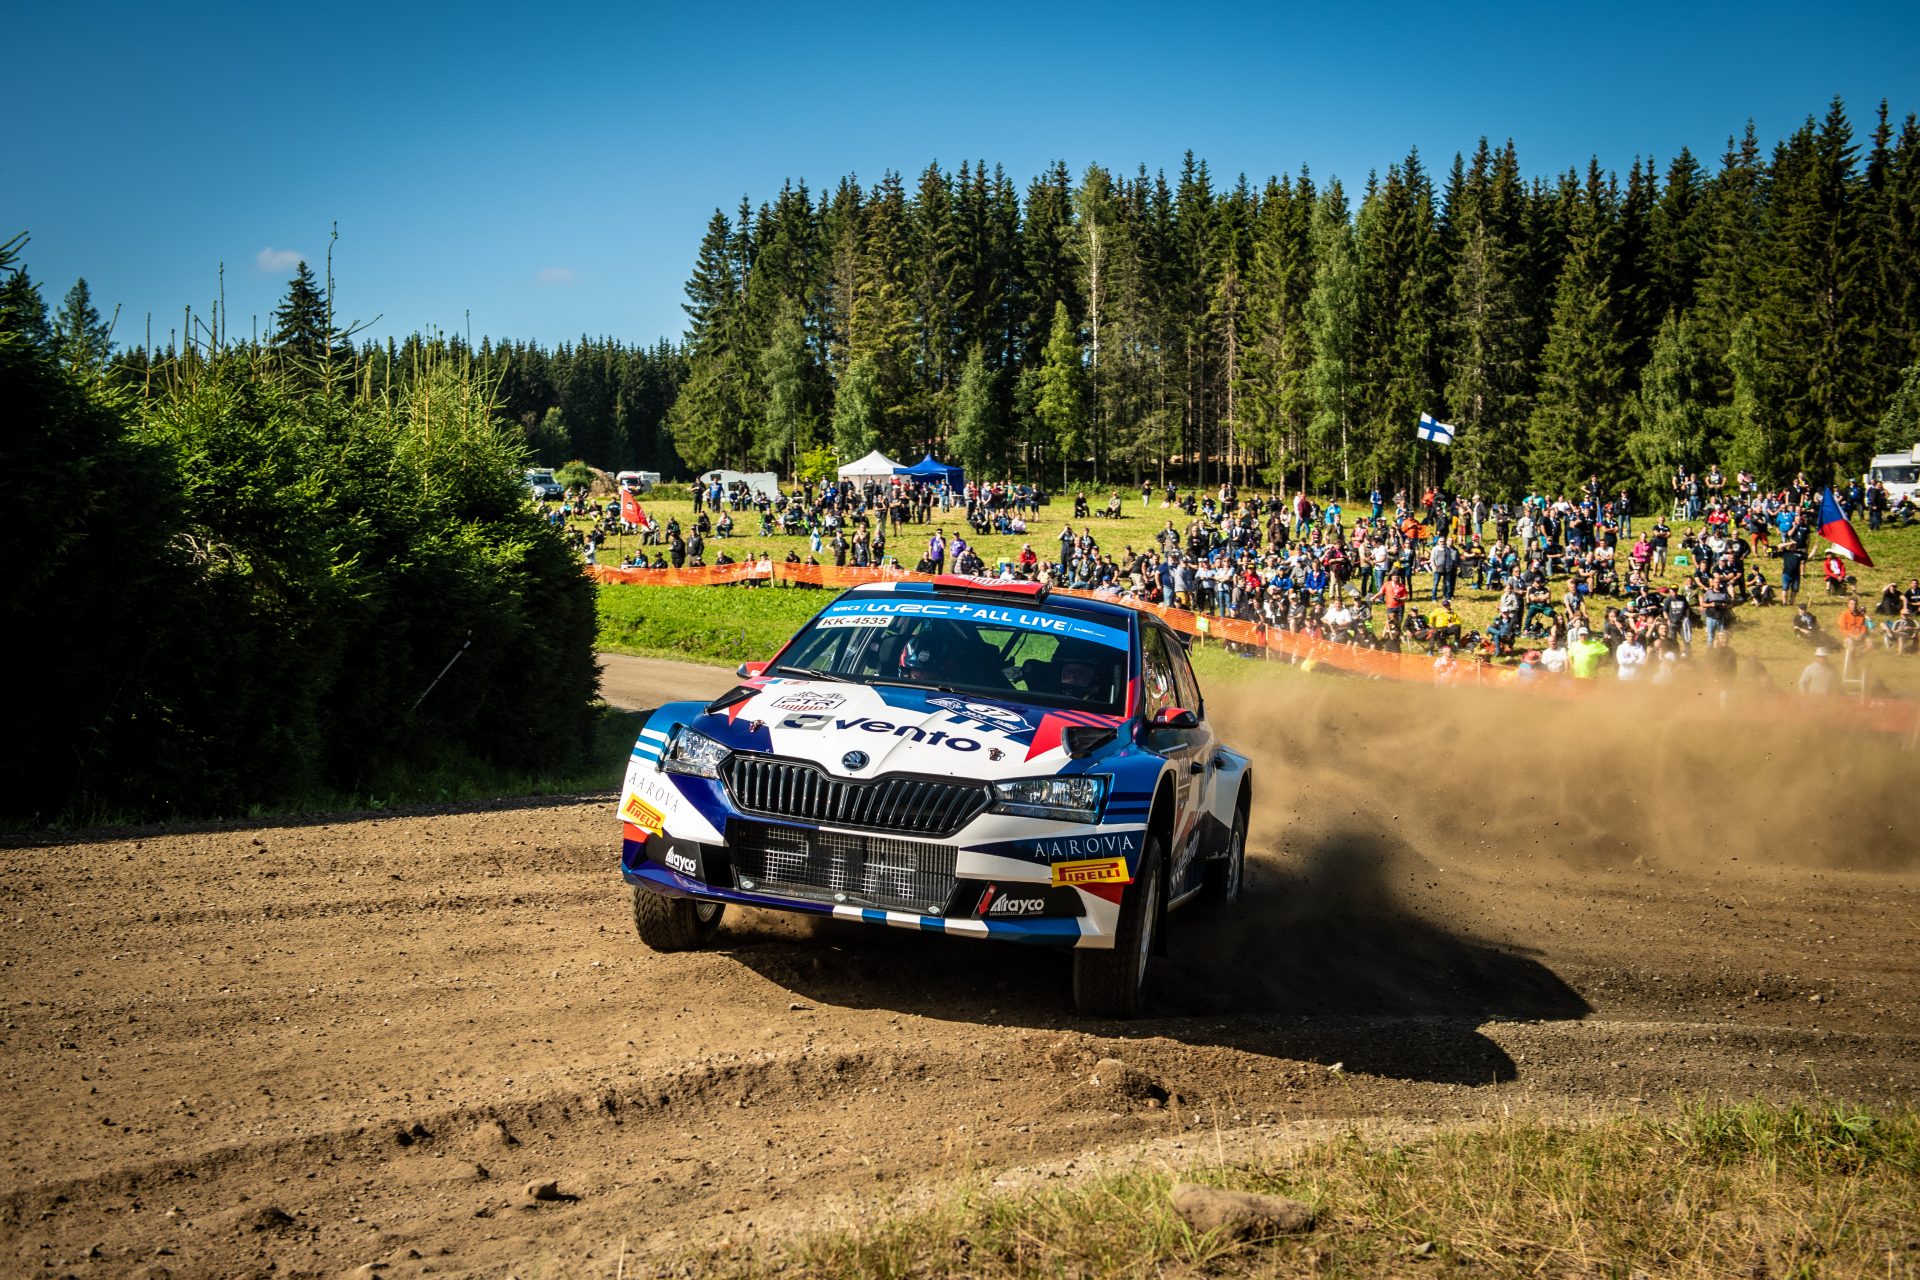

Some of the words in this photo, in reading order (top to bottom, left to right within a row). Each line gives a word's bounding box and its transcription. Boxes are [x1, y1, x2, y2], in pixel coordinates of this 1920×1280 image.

[822, 616, 888, 626] KK-4535
[972, 609, 1012, 622] ALL
[1019, 614, 1068, 631] LIVE
[836, 717, 982, 752] vento
[628, 772, 679, 813] AAROVA
[626, 798, 661, 829] PIRELLI
[1058, 861, 1120, 882] PIRELLI
